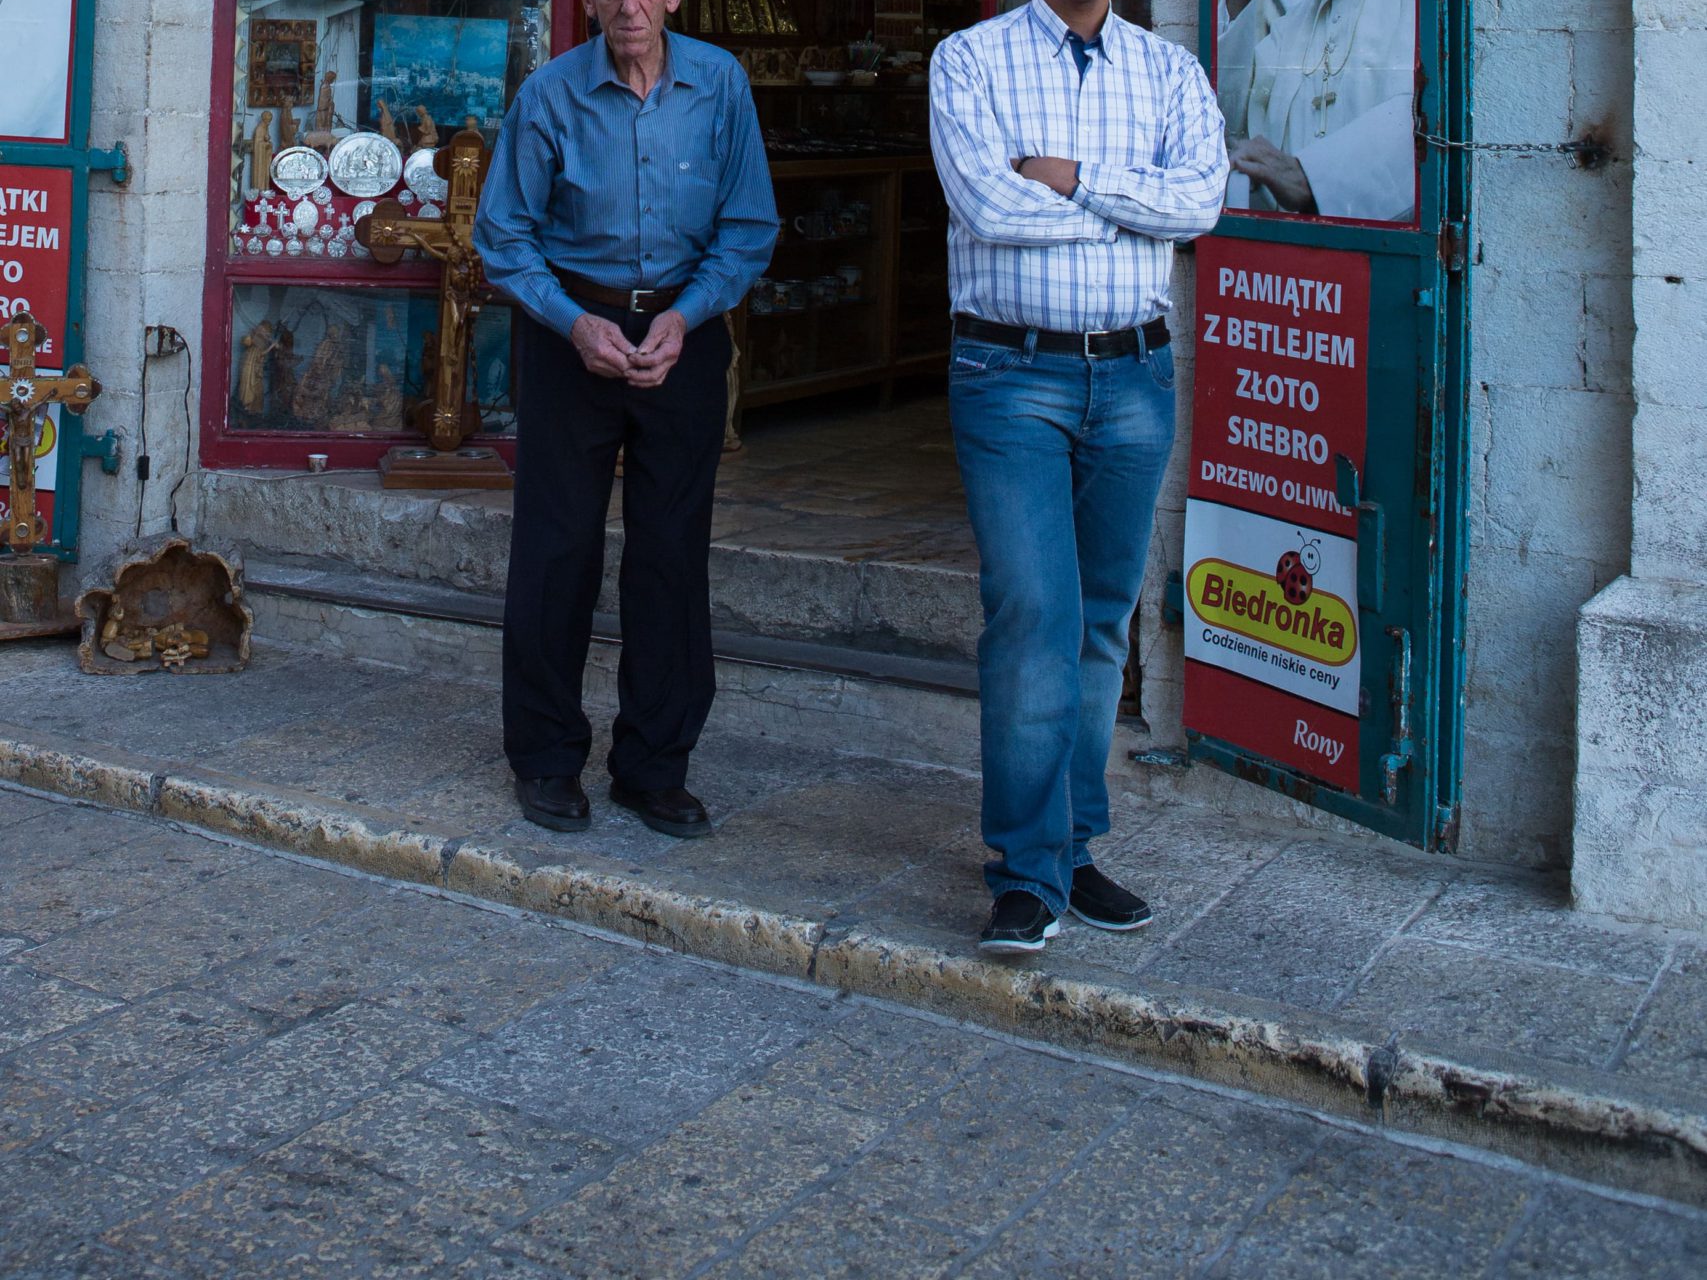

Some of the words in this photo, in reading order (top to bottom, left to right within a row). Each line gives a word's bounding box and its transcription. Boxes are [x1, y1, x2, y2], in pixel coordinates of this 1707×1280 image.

[1218, 267, 1342, 317] PAMIĄTKI
[1203, 313, 1221, 344] Z
[1226, 317, 1355, 368] BETLEJEM
[1235, 367, 1320, 412] ZŁOTO
[1227, 415, 1329, 465] SREBRO
[1201, 460, 1278, 497] DRZEWO
[1201, 573, 1345, 650] Biedronka
[1202, 628, 1268, 662] Codziennie
[1271, 653, 1306, 676] niskie
[1309, 666, 1340, 690] ceny
[1293, 719, 1345, 765] Rony
